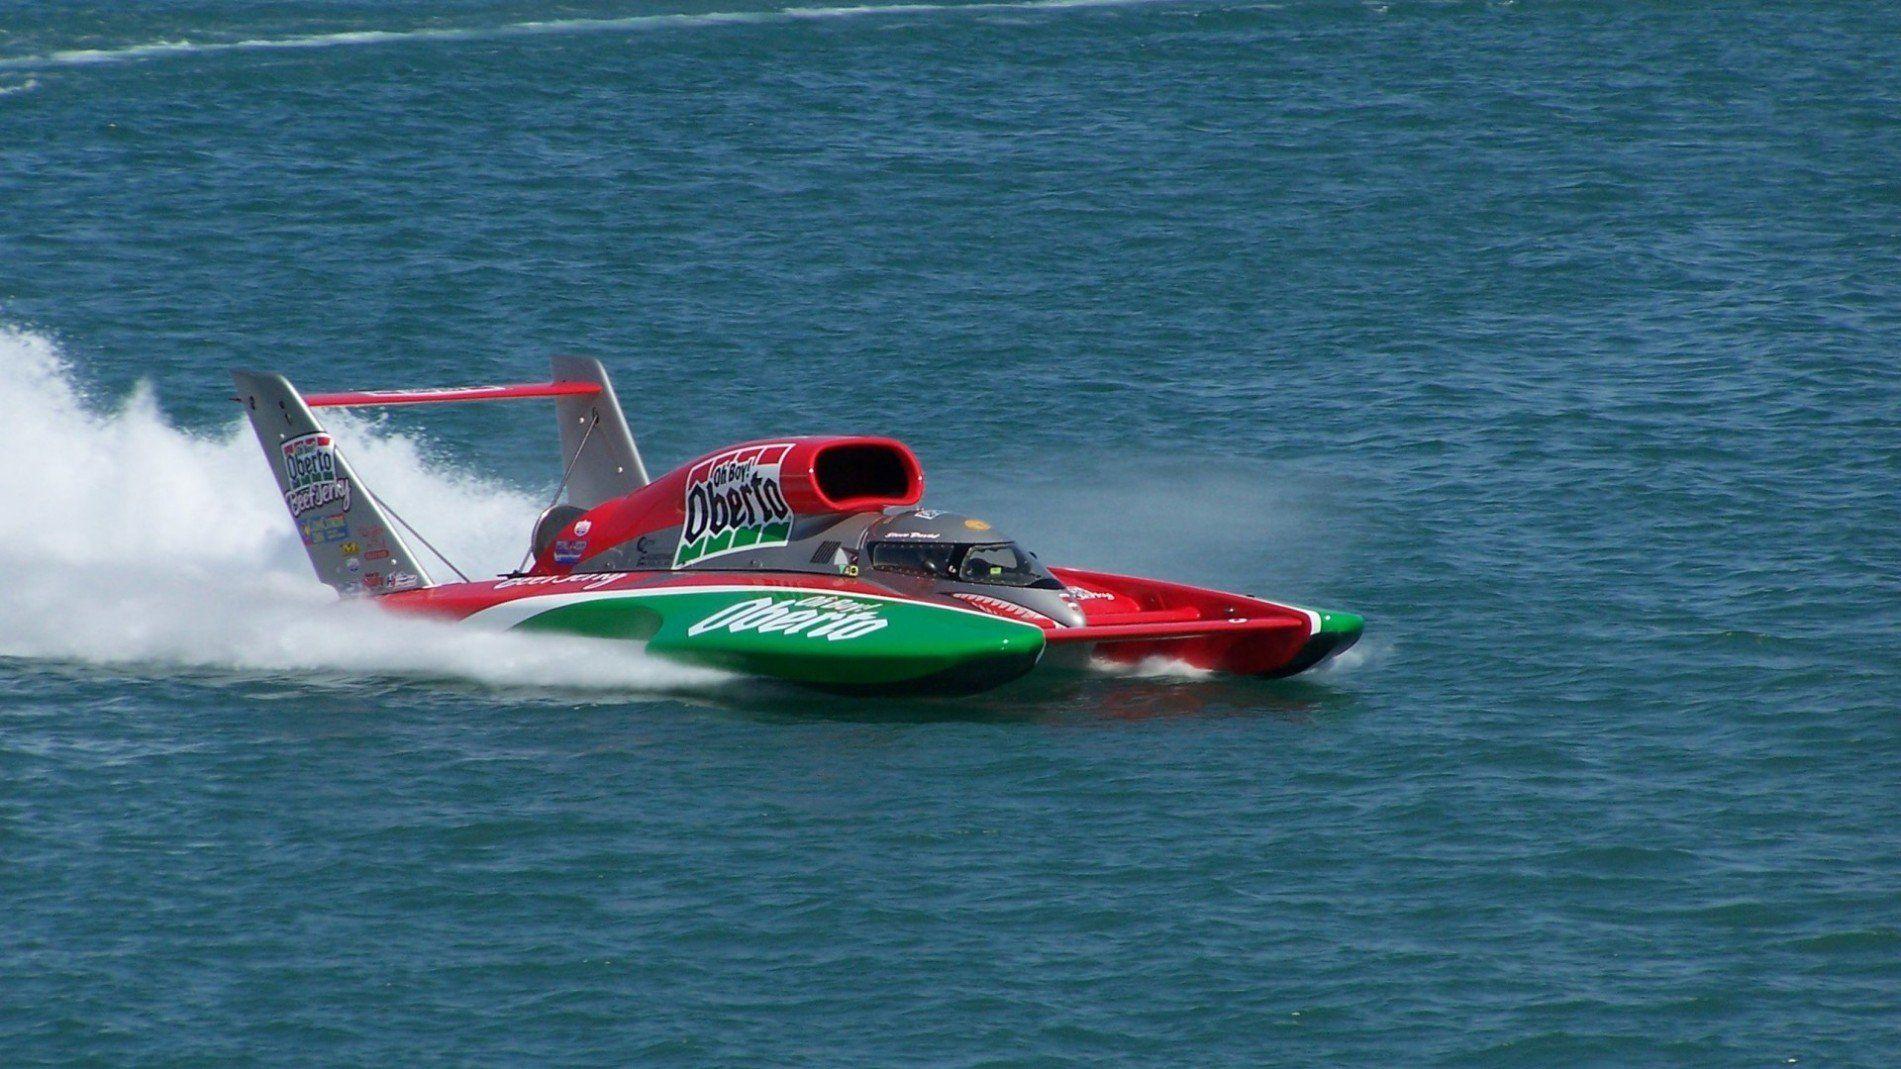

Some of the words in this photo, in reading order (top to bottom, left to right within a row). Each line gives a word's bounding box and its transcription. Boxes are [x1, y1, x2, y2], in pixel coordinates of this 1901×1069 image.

[287, 449, 332, 480] Oberto
[713, 466, 727, 487] Oh
[728, 462, 752, 483] Boy!
[684, 472, 789, 544] Oberto
[687, 596, 889, 642] Oberto
